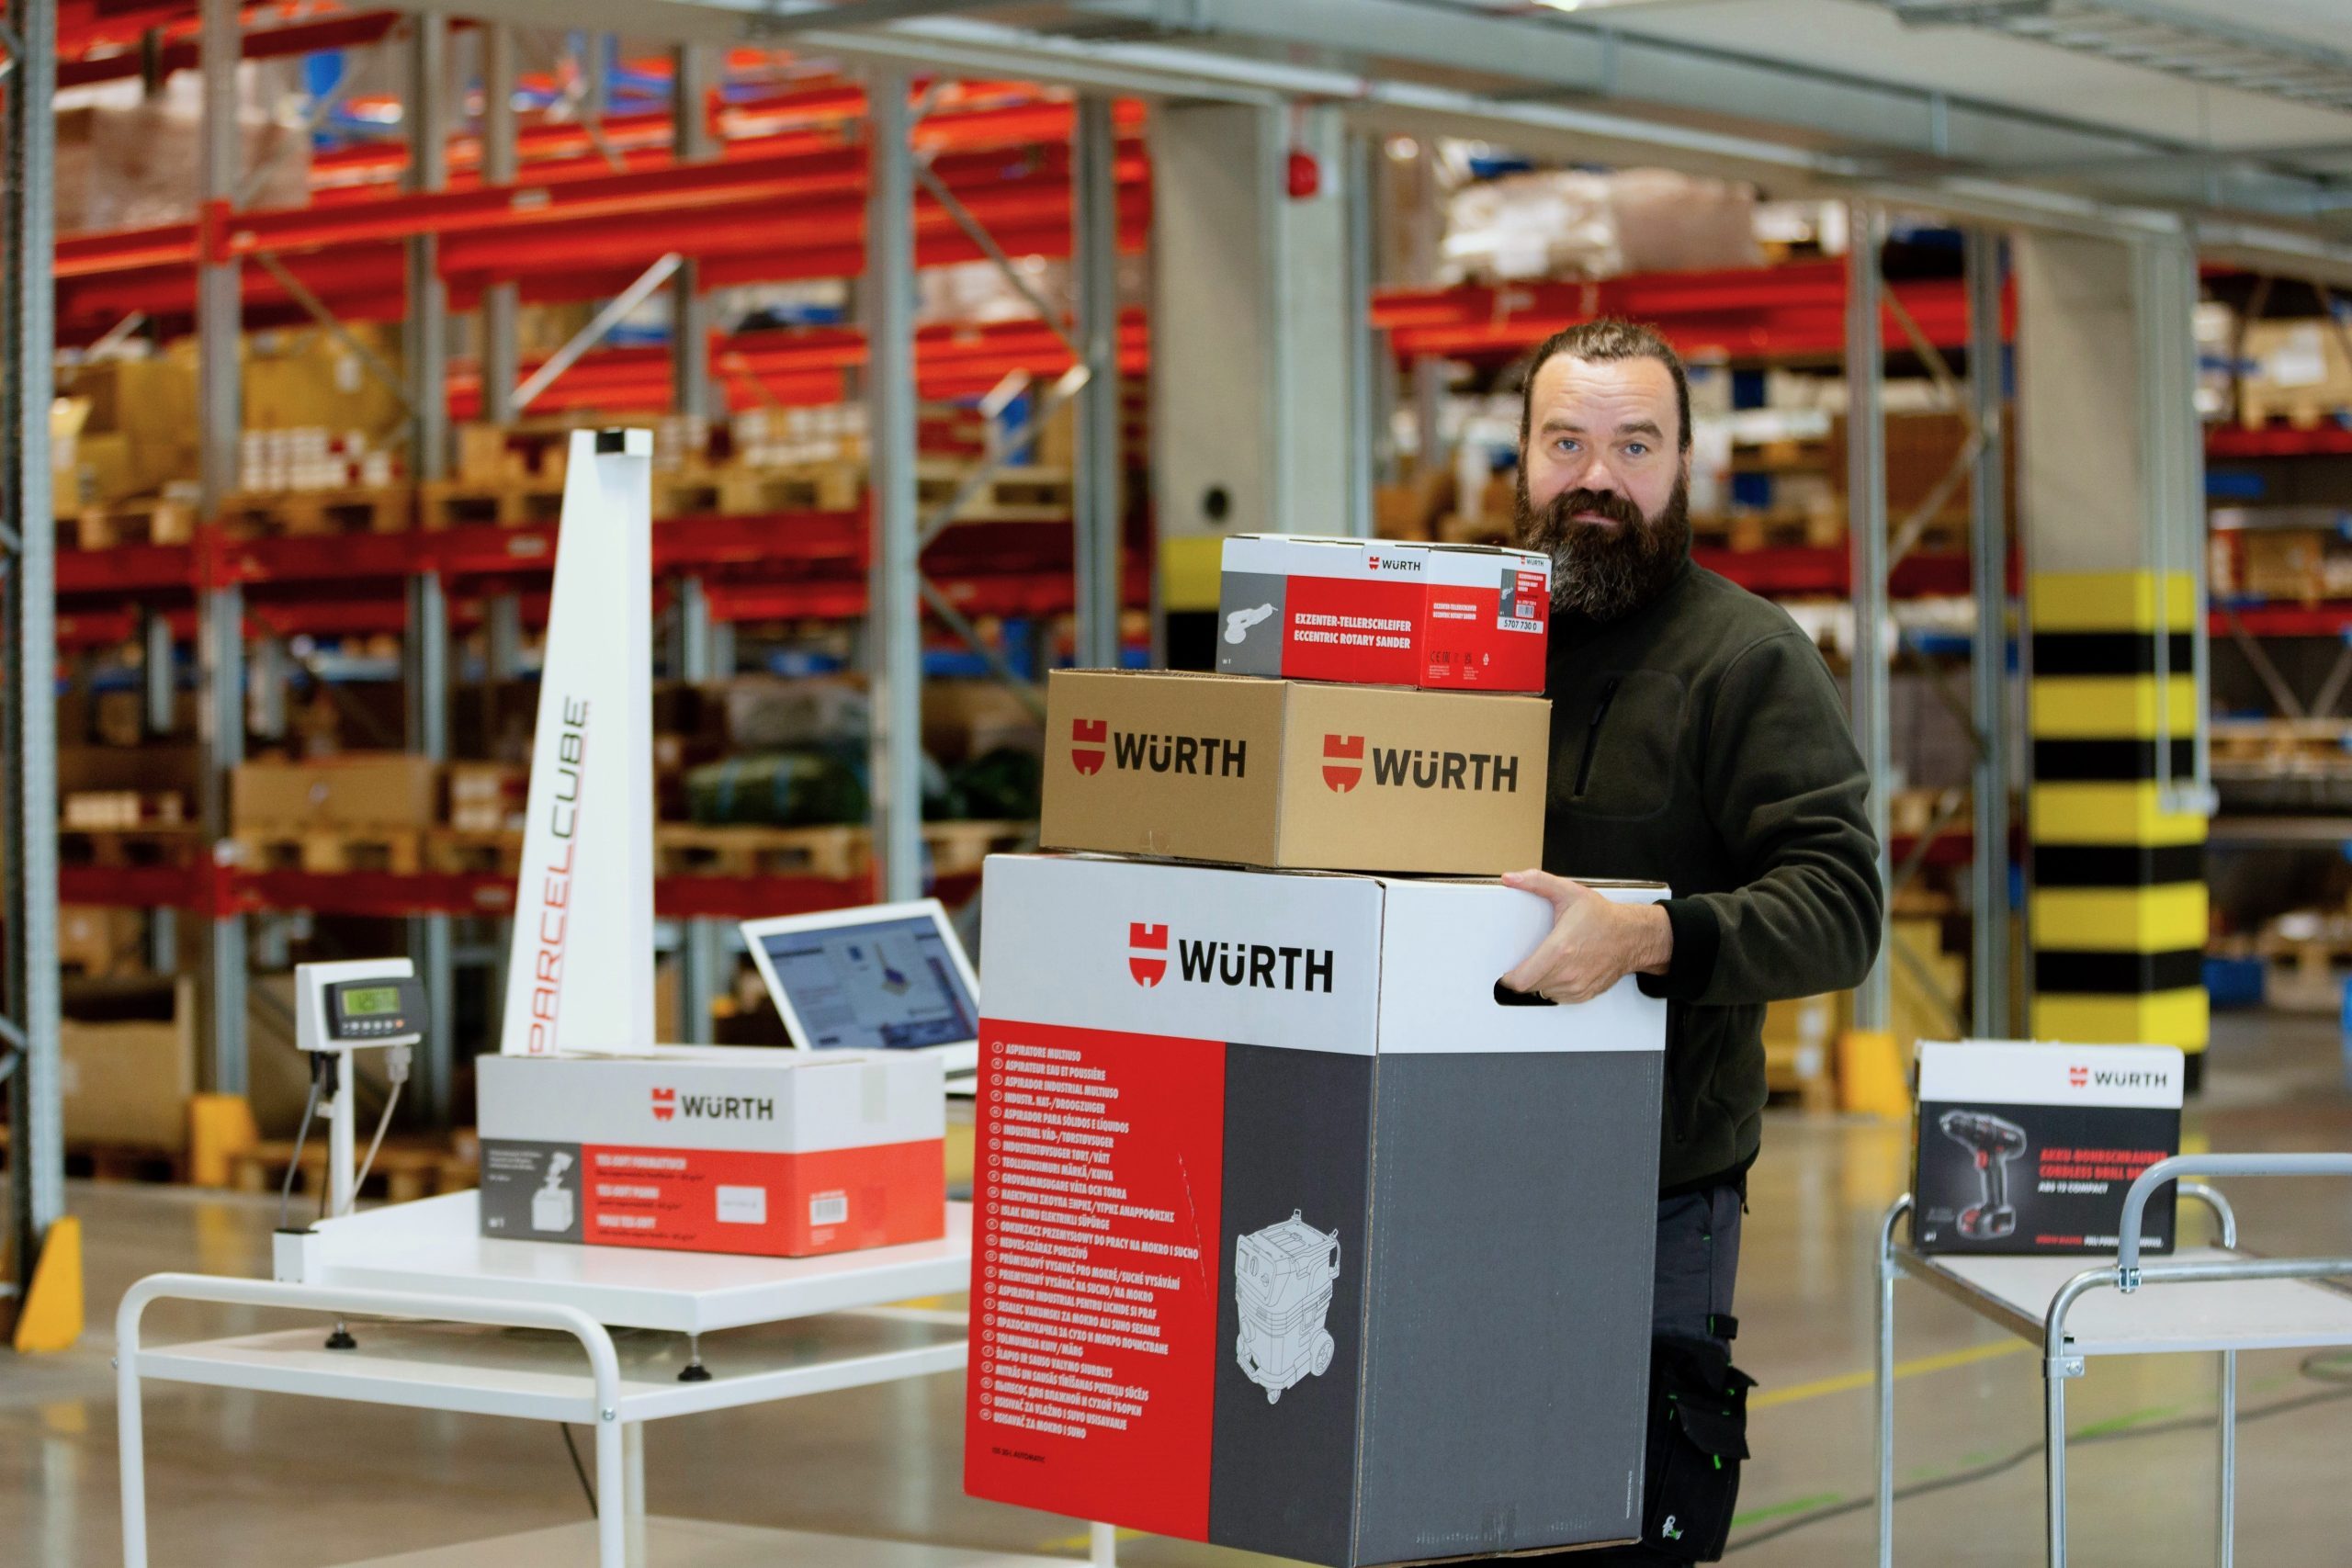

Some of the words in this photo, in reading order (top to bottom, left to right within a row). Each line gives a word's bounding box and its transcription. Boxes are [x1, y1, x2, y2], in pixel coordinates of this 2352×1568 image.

[1382, 559, 1420, 571] WÜRTH
[1295, 613, 1412, 632] EXZENTER-TELLERSCHLEIFER
[1504, 619, 1519, 629] 5707
[1521, 621, 1532, 630] 730
[1294, 629, 1339, 644] ECCENTRIC
[1340, 633, 1374, 647] ROTARY
[1375, 636, 1411, 649] SANDER
[1114, 731, 1247, 778] WÜRTH
[1372, 748, 1519, 793] WÜRTH
[529, 695, 588, 1055] PARCELCUBE
[1179, 939, 1334, 993] WÜRTH
[1005, 1043, 1046, 1058] ASPIRATORE
[1047, 1048, 1081, 1062] MULTIUSO
[1005, 1060, 1046, 1074] ASPIRATEUR
[1046, 1065, 1060, 1076] EAU
[1061, 1066, 1069, 1077] ET
[1004, 1077, 1044, 1090] ASPIRADOR
[1044, 1080, 1083, 1095] INDUSTRIAL
[1084, 1085, 1118, 1099] MULTIUSO
[682, 1096, 774, 1121] WÜRTH
[1003, 1109, 1043, 1122] ASPIRADOR
[1043, 1113, 1062, 1125] PARA
[1062, 1113, 1091, 1129] SÓLIDOS
[1091, 1119, 1095, 1129] E
[1096, 1117, 1129, 1134] LÍQUIDOS
[1088, 1184, 1102, 1196] OCH
[1102, 1186, 1126, 1200] TORRA
[1021, 1208, 1040, 1220] KURU
[1094, 1235, 1104, 1246] DO
[1105, 1236, 1129, 1249] PRACY
[1130, 1240, 1140, 1251] NA
[1141, 1241, 1170, 1255] MOKRO
[1170, 1246, 1172, 1256] I
[1173, 1246, 1198, 1259] SUCHO
[1076, 1264, 1091, 1276] PRO
[1035, 1291, 1075, 1307] INDUSTRIAL
[1076, 1280, 1086, 1292] NA
[1087, 1282, 1125, 1298] SUCHO/NA
[1125, 1289, 1153, 1303] MOKRO
[1061, 1311, 1070, 1322] ZA
[1072, 1313, 1099, 1326] MOKRO
[1100, 1317, 1111, 1328] ALI
[1112, 1319, 1131, 1332] SUHO
[1069, 1328, 1087, 1341] СУХО
[1094, 1333, 1121, 1347] МОКРО
[1025, 1402, 1034, 1413] ZA
[1063, 1409, 1066, 1418] I
[1026, 1418, 1035, 1429] ZA
[1063, 1426, 1067, 1435] I
